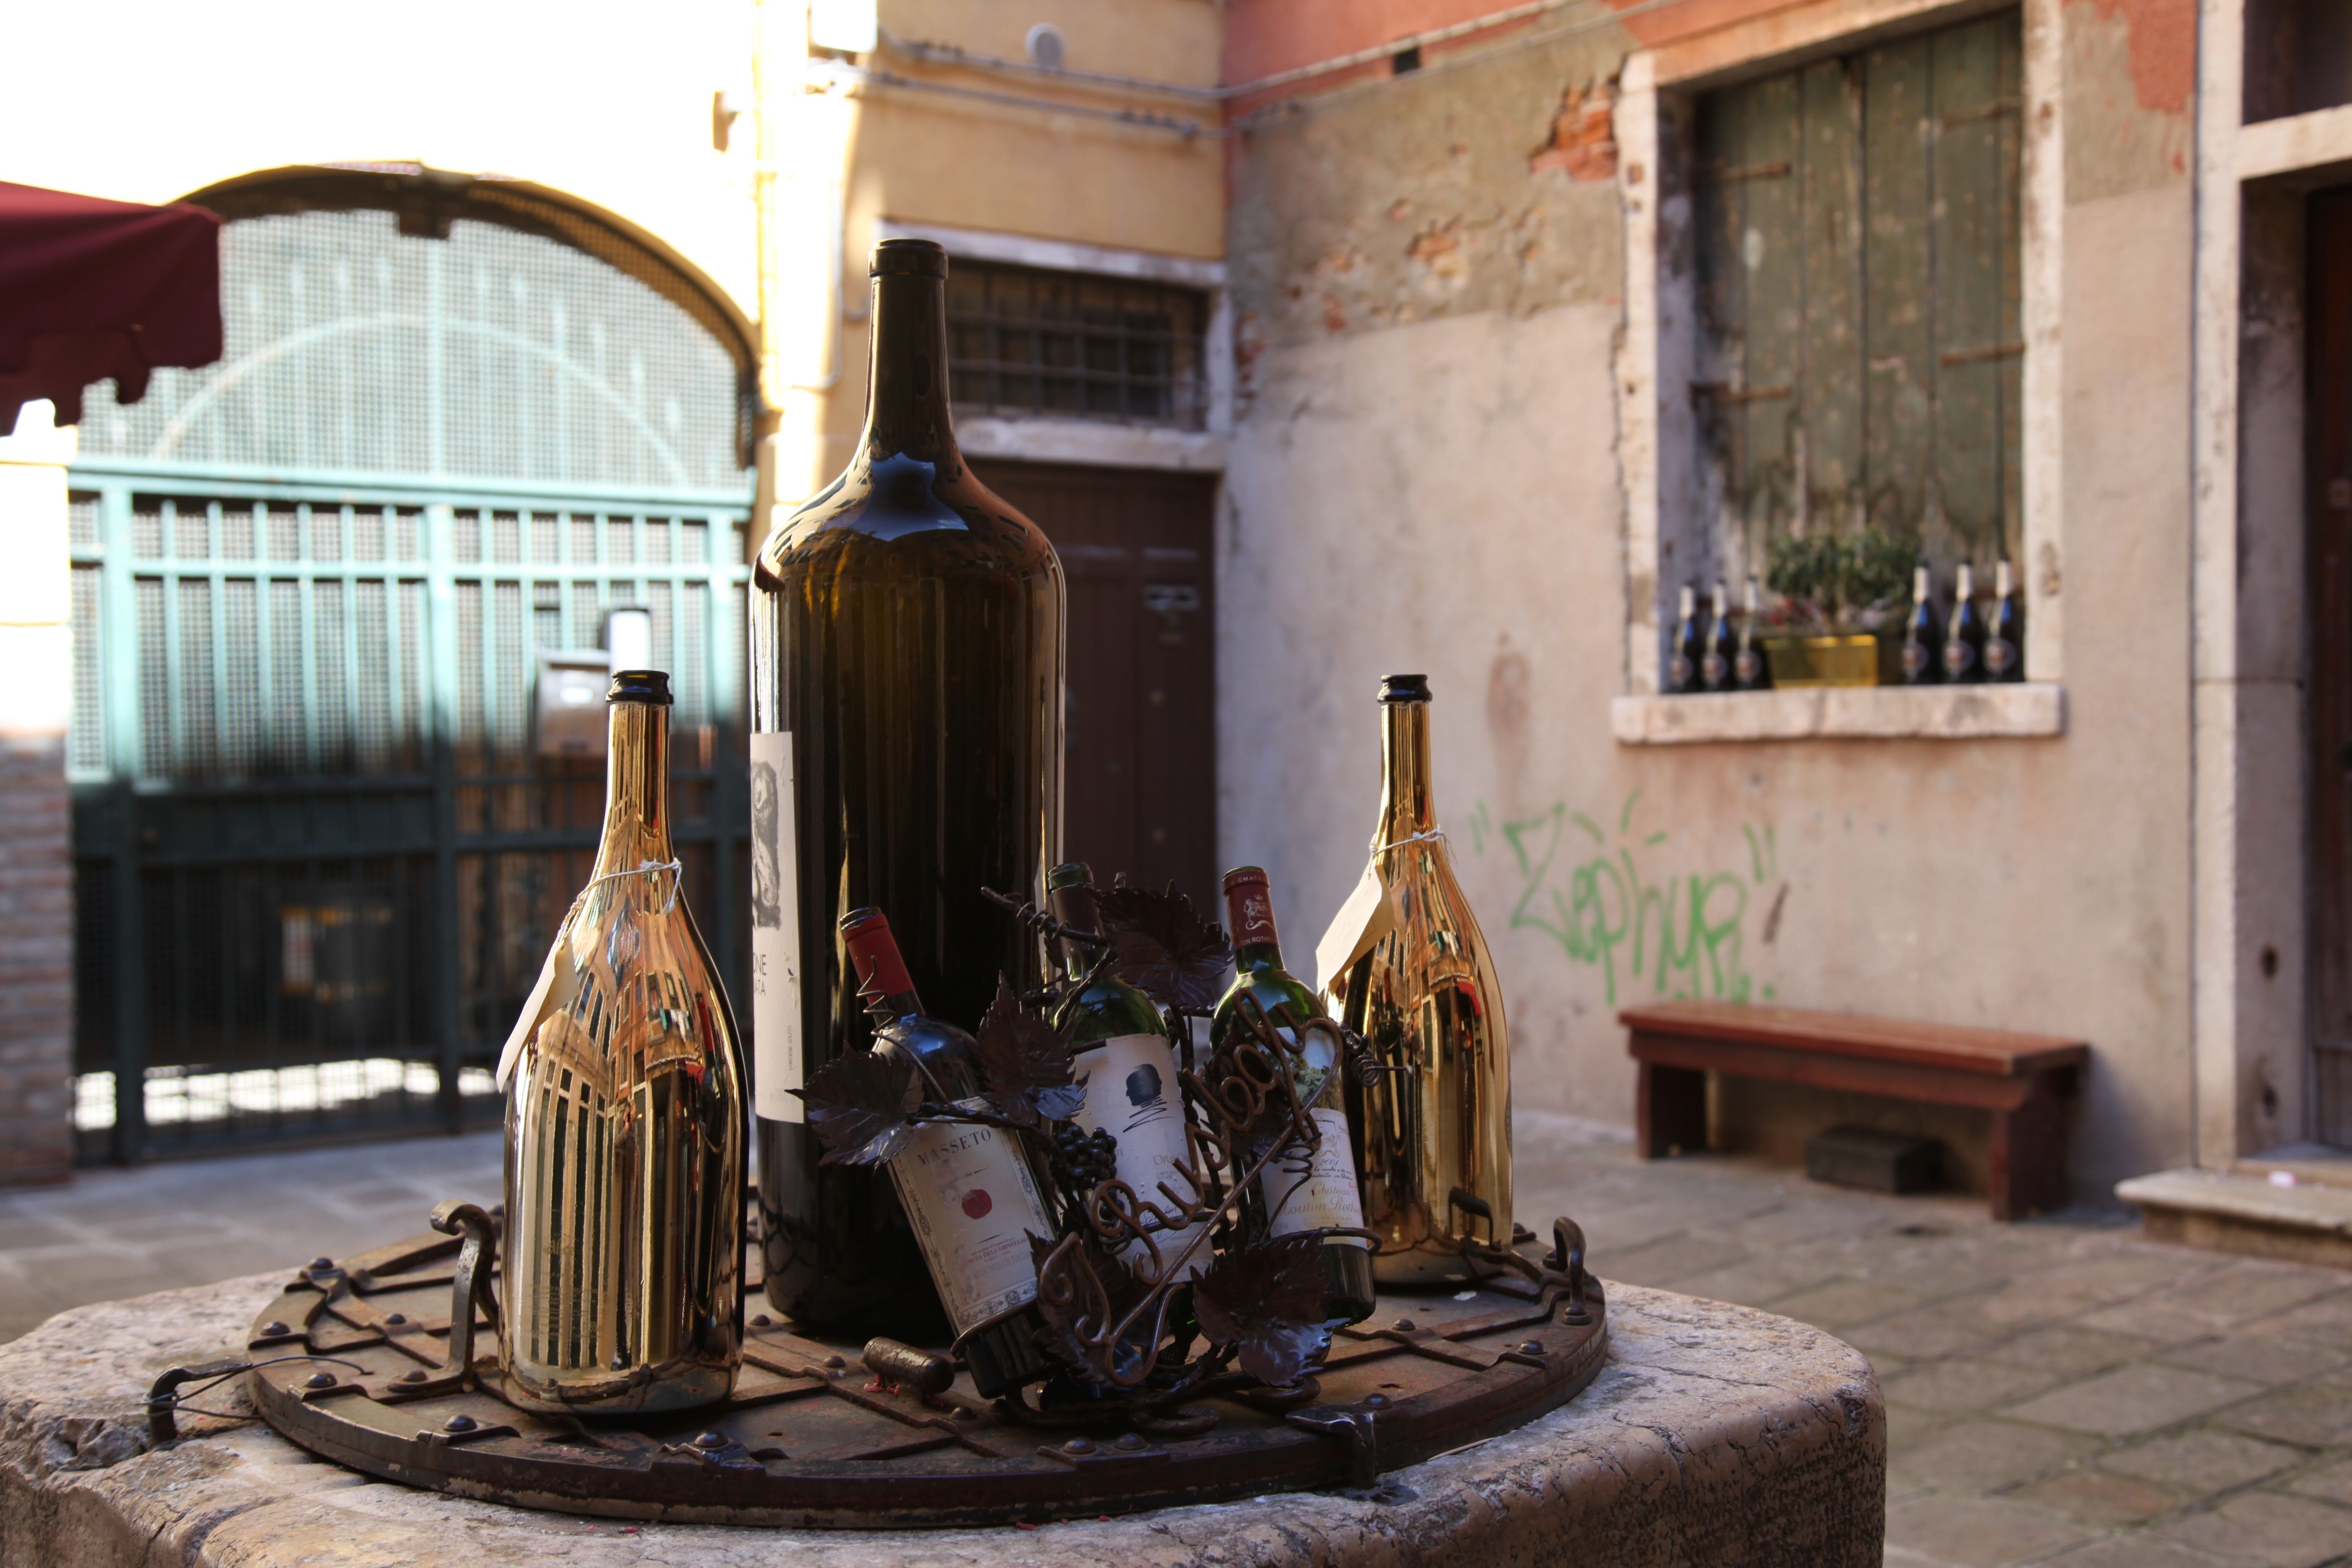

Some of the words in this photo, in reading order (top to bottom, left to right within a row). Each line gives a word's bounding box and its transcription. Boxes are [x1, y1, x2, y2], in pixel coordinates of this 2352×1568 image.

[1240, 938, 1251, 946] TON
[916, 1128, 992, 1168] MASSETO
[1313, 1181, 1349, 1195] Château
